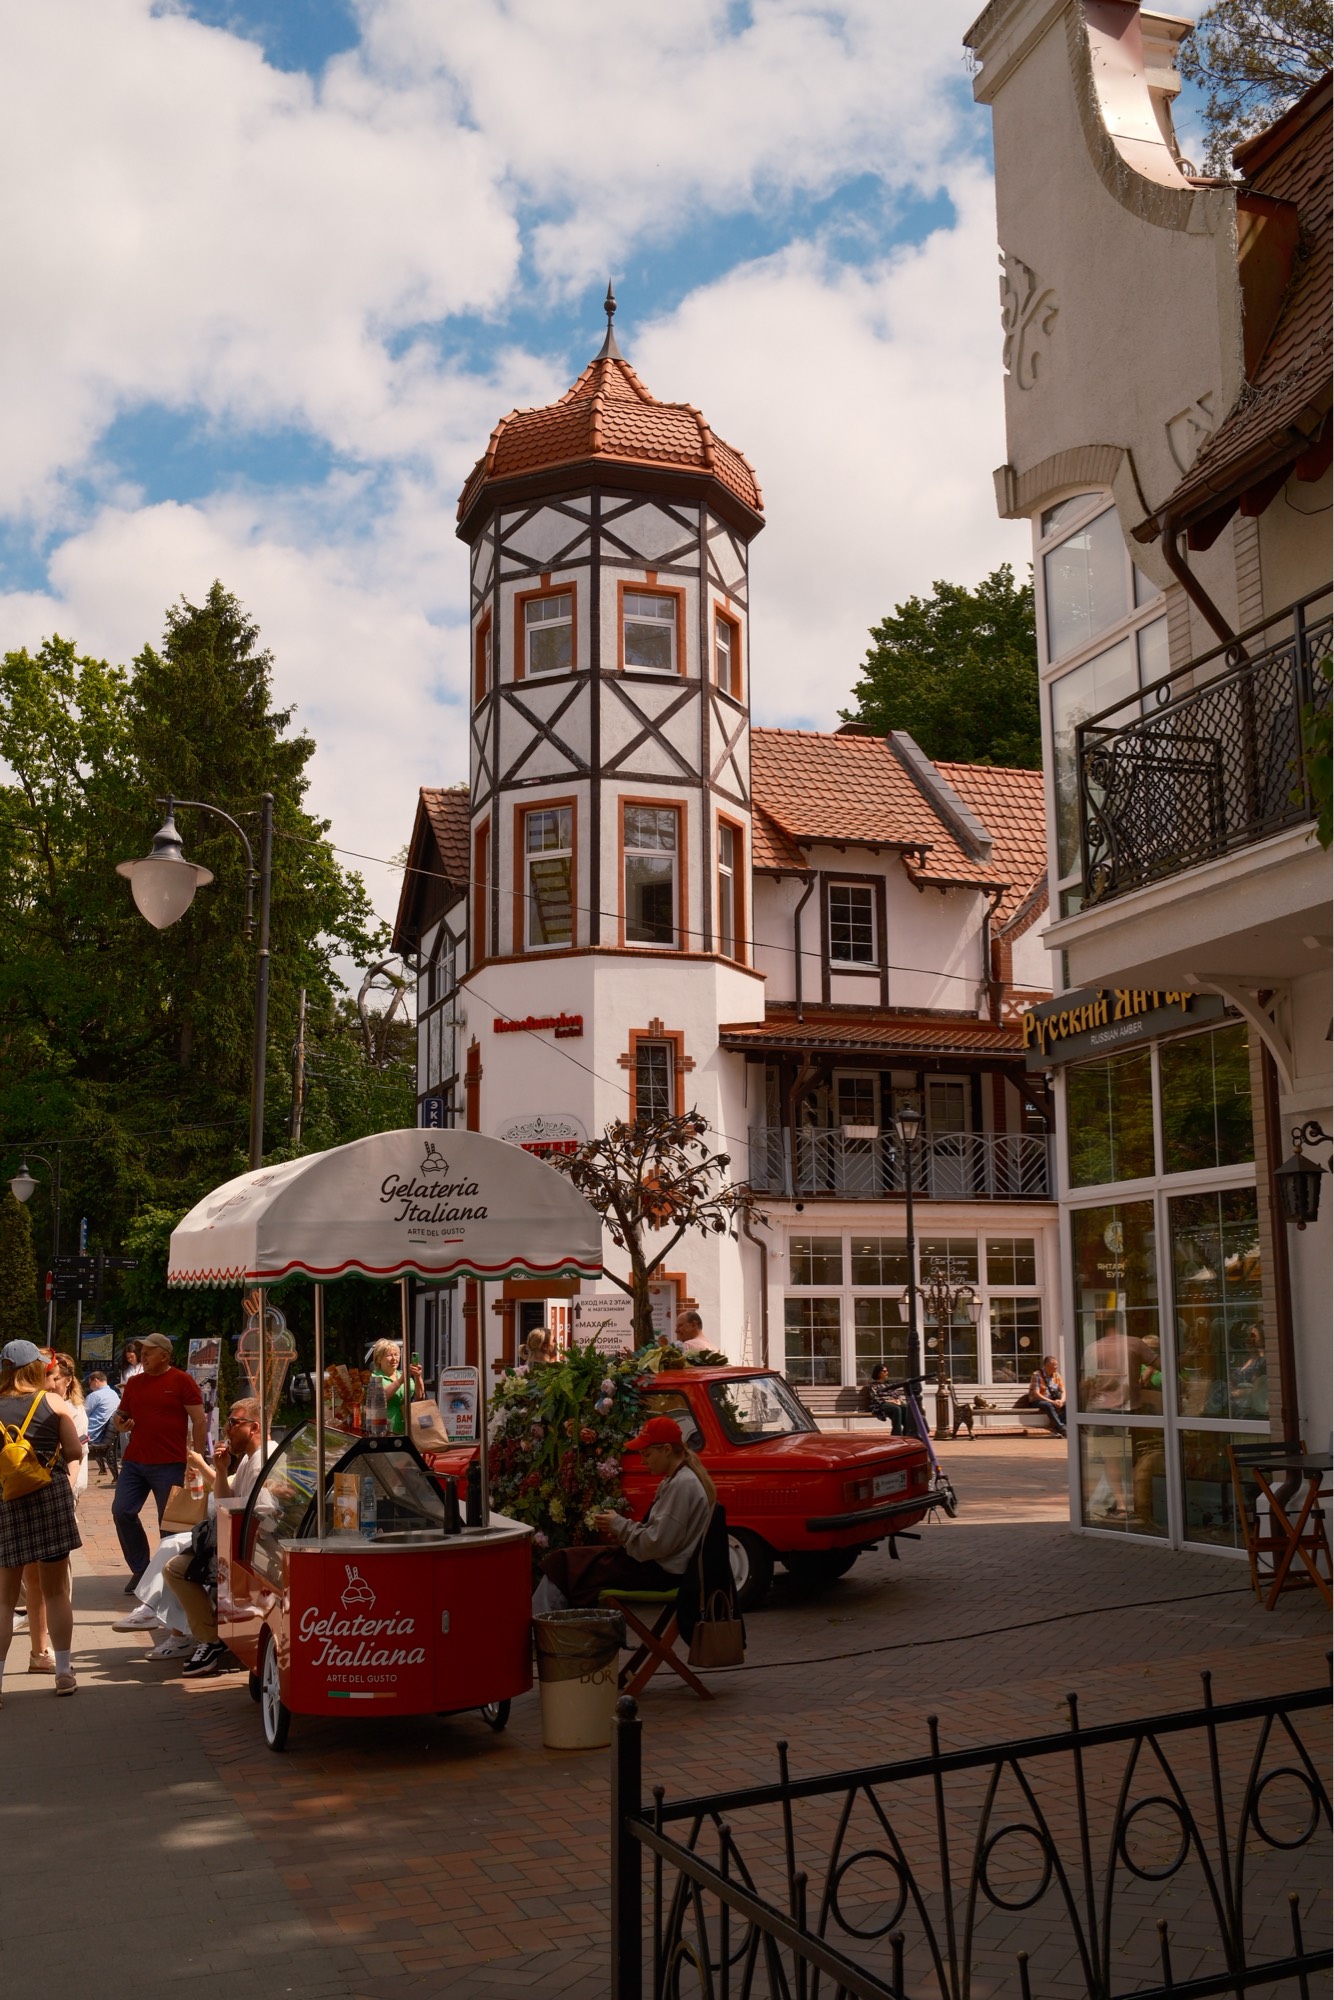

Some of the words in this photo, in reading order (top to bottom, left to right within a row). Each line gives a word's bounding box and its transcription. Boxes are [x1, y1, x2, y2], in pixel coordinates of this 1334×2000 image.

[1021, 989, 1109, 1056] Русский
[1113, 990, 1200, 1020] Янтар
[1090, 1028, 1120, 1046] RUSSIAN
[1118, 1020, 1144, 1037] AMBER
[380, 1174, 479, 1203] Gelateria
[393, 1198, 488, 1223] Italiana
[407, 1228, 426, 1236] ARTE
[426, 1229, 440, 1237] DEL
[441, 1227, 466, 1236] GUSTO
[575, 1336, 623, 1345] «ЭЙОРИЯ»
[456, 1414, 473, 1424] ВАМ
[298, 1607, 415, 1642] Gelateria
[311, 1637, 426, 1667] Italiana
[326, 1674, 348, 1683] ARTE
[349, 1674, 365, 1683] DEL
[367, 1674, 398, 1683] GUSTO
